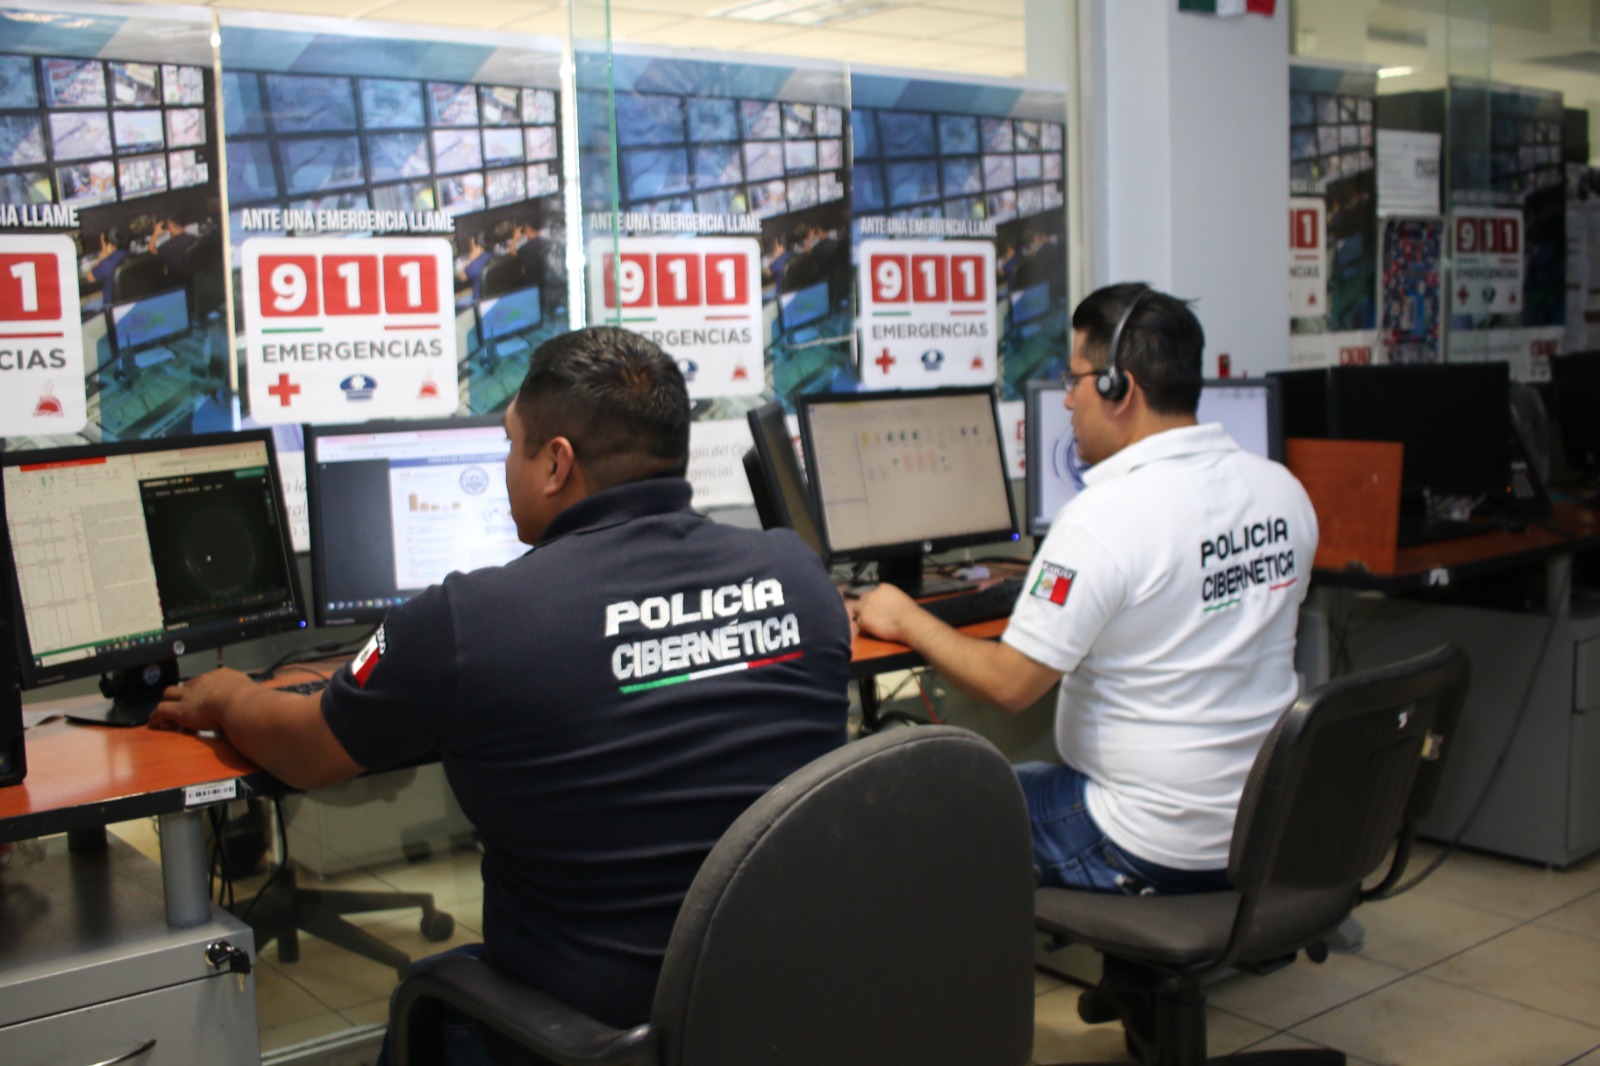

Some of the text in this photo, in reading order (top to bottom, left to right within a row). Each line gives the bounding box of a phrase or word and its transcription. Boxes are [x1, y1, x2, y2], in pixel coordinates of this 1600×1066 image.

[22, 203, 80, 227] LLAME
[242, 208, 455, 231] ANTE UNA EMERGENCIA LLAME
[590, 212, 762, 232] ANTE UNA EMERGENCIA LLAME
[861, 216, 885, 233] ANTE
[888, 217, 907, 233] UNA
[908, 218, 967, 235] EMERGENCIA
[641, 327, 752, 347] RGENCIAS
[872, 322, 988, 340] EMERGENCIAS
[0, 349, 67, 370] CIAS
[262, 339, 443, 363] EMERGENCIAS
[689, 463, 734, 482] gencias
[1201, 516, 1288, 568] POLICÍA
[1203, 549, 1294, 602] CIBERNÉTICA
[605, 577, 785, 637] POLICÍA
[612, 613, 801, 680] CIBERNÉTICA
